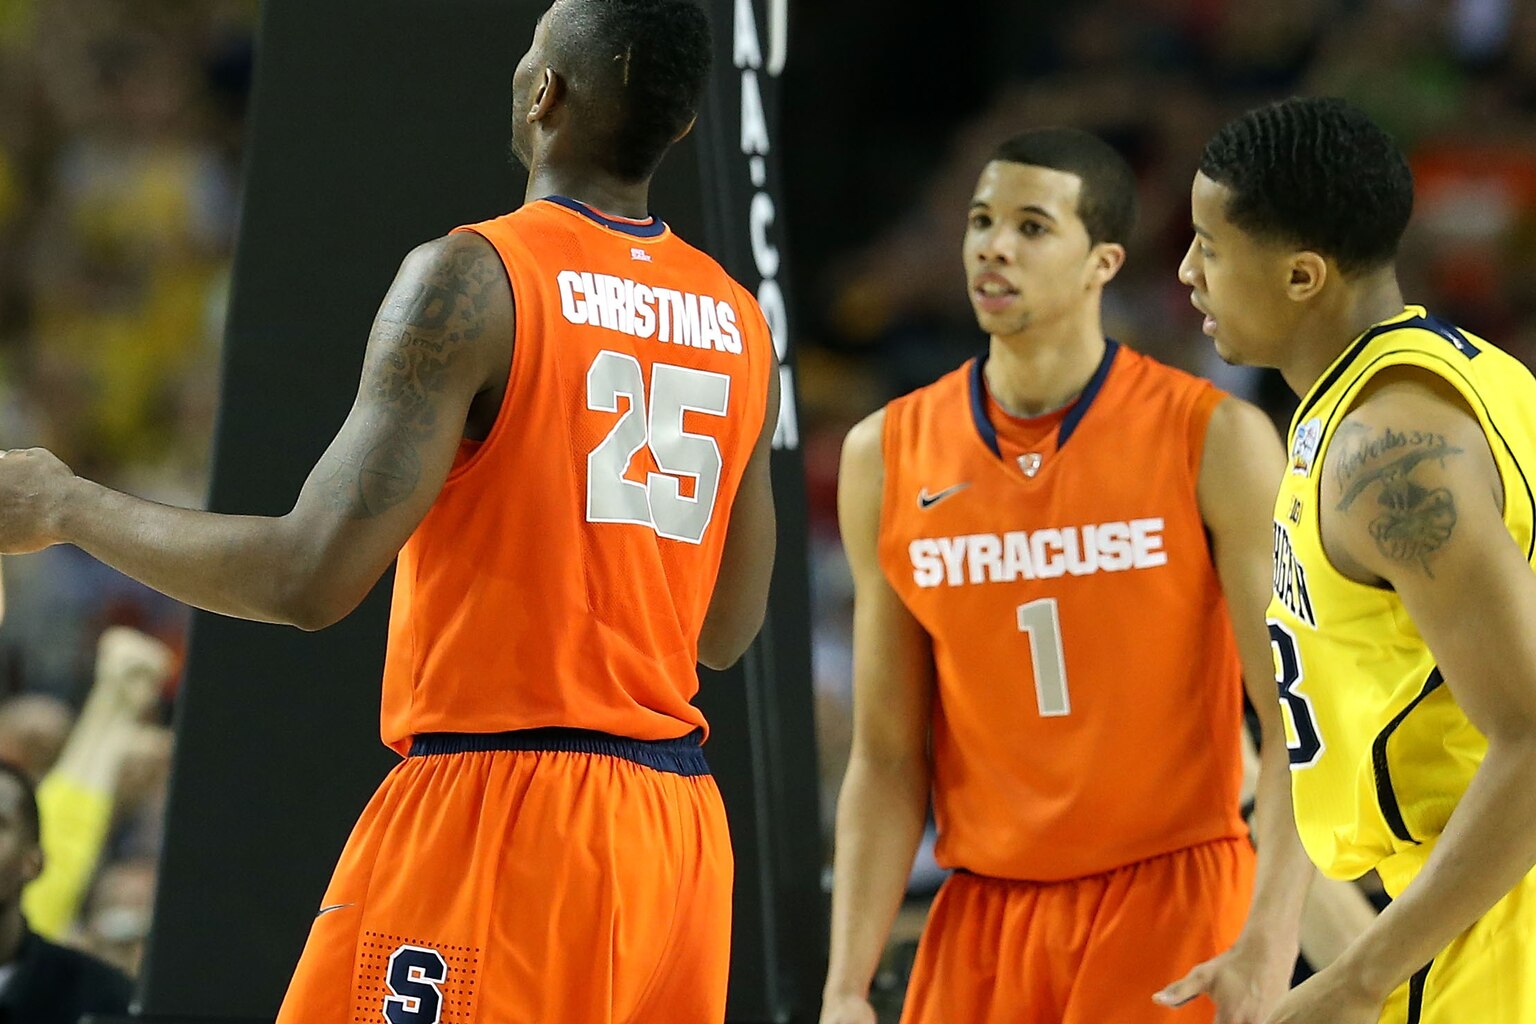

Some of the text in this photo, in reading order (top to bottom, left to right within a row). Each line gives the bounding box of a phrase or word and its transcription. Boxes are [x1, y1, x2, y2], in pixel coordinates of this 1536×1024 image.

[557, 270, 743, 355] CHRISTMAS
[586, 349, 731, 544] 25
[909, 517, 1167, 587] SYRACUSE
[1016, 597, 1070, 717] 1
[382, 944, 447, 1024] S
